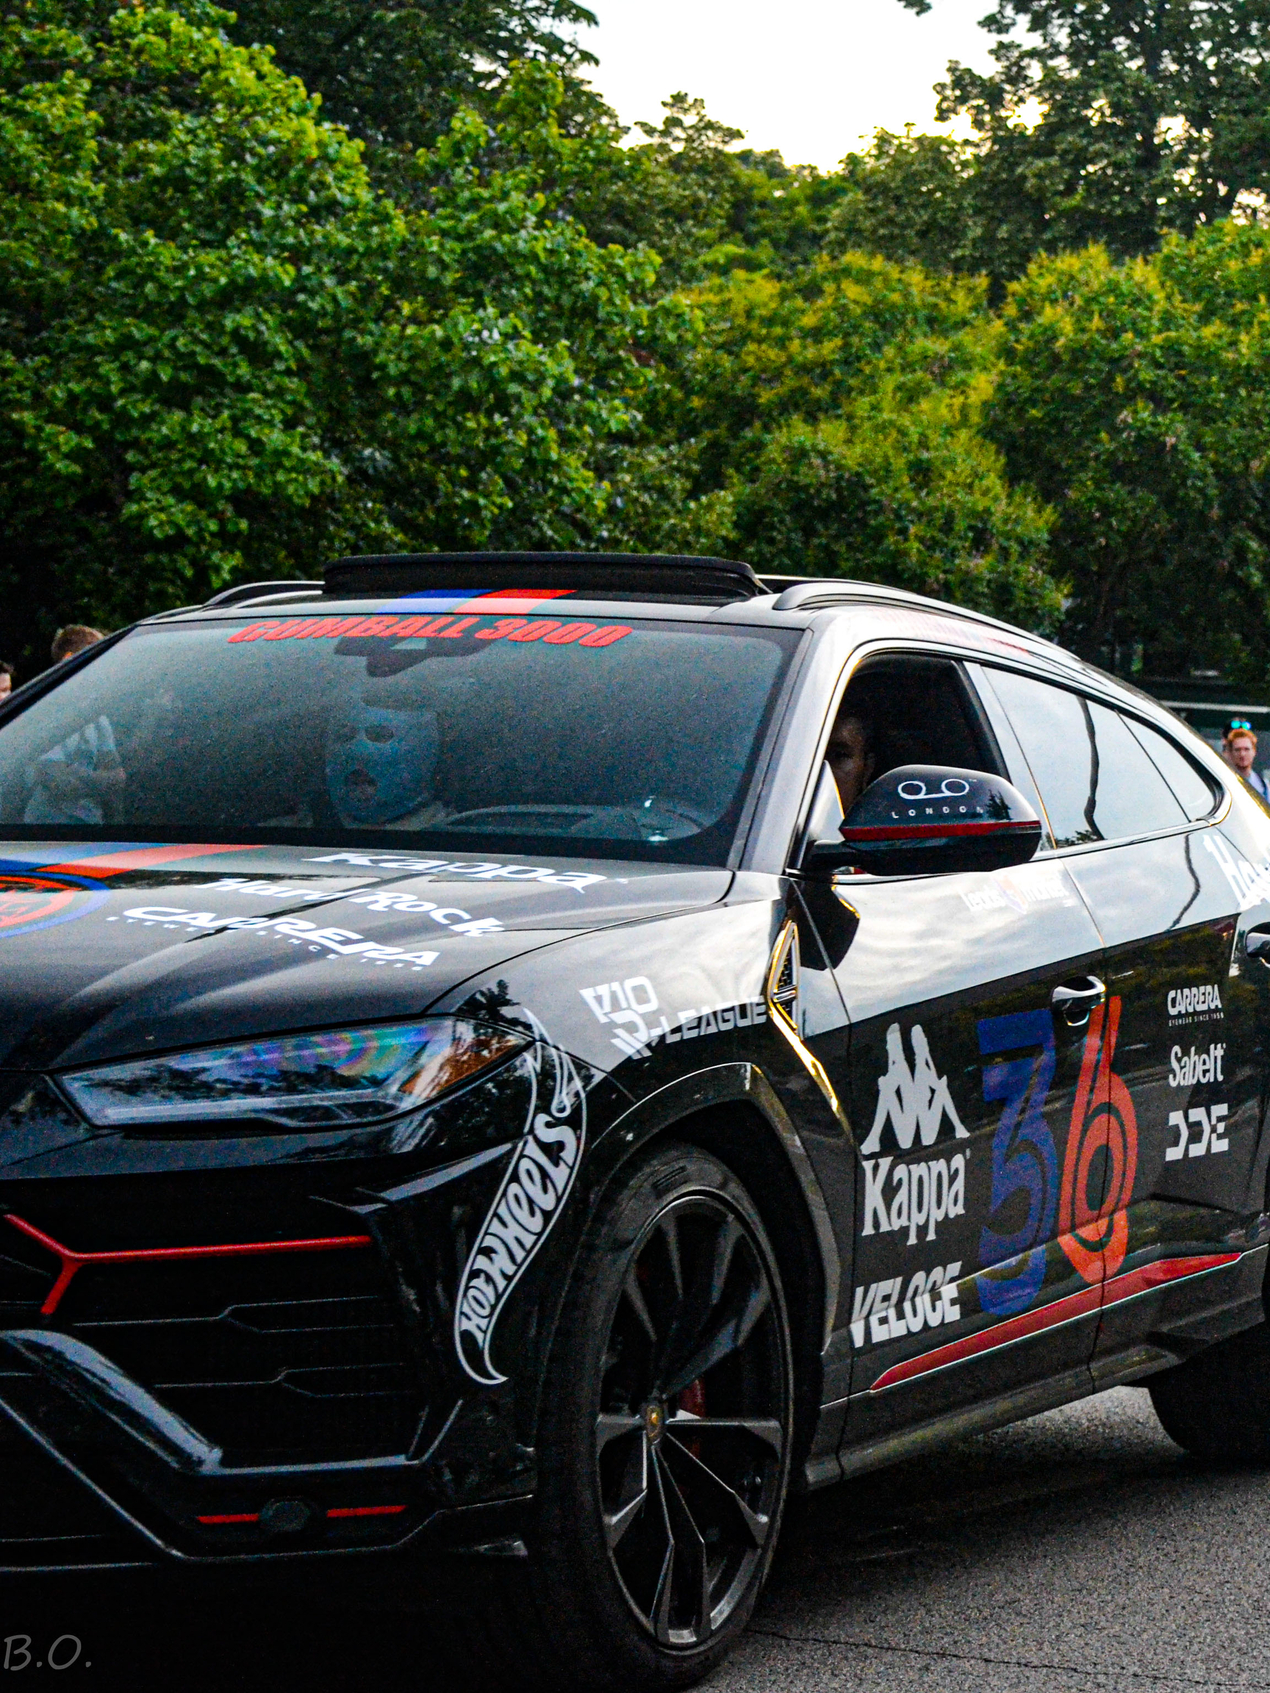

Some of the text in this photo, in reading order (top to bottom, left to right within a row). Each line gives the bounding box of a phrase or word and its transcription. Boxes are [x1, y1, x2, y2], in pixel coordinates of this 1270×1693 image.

[227, 617, 633, 647] GUMBALL 3000
[892, 806, 984, 819] LONDON
[303, 852, 607, 894] Kappa
[194, 878, 506, 938] Hard Rock
[123, 906, 440, 966] CARRERA
[1167, 983, 1222, 1016] CARRERA
[1169, 1043, 1225, 1088] Sabelt
[976, 995, 1138, 1315] 36
[862, 1153, 966, 1246] Kappa
[850, 1261, 963, 1349] VELOCE
